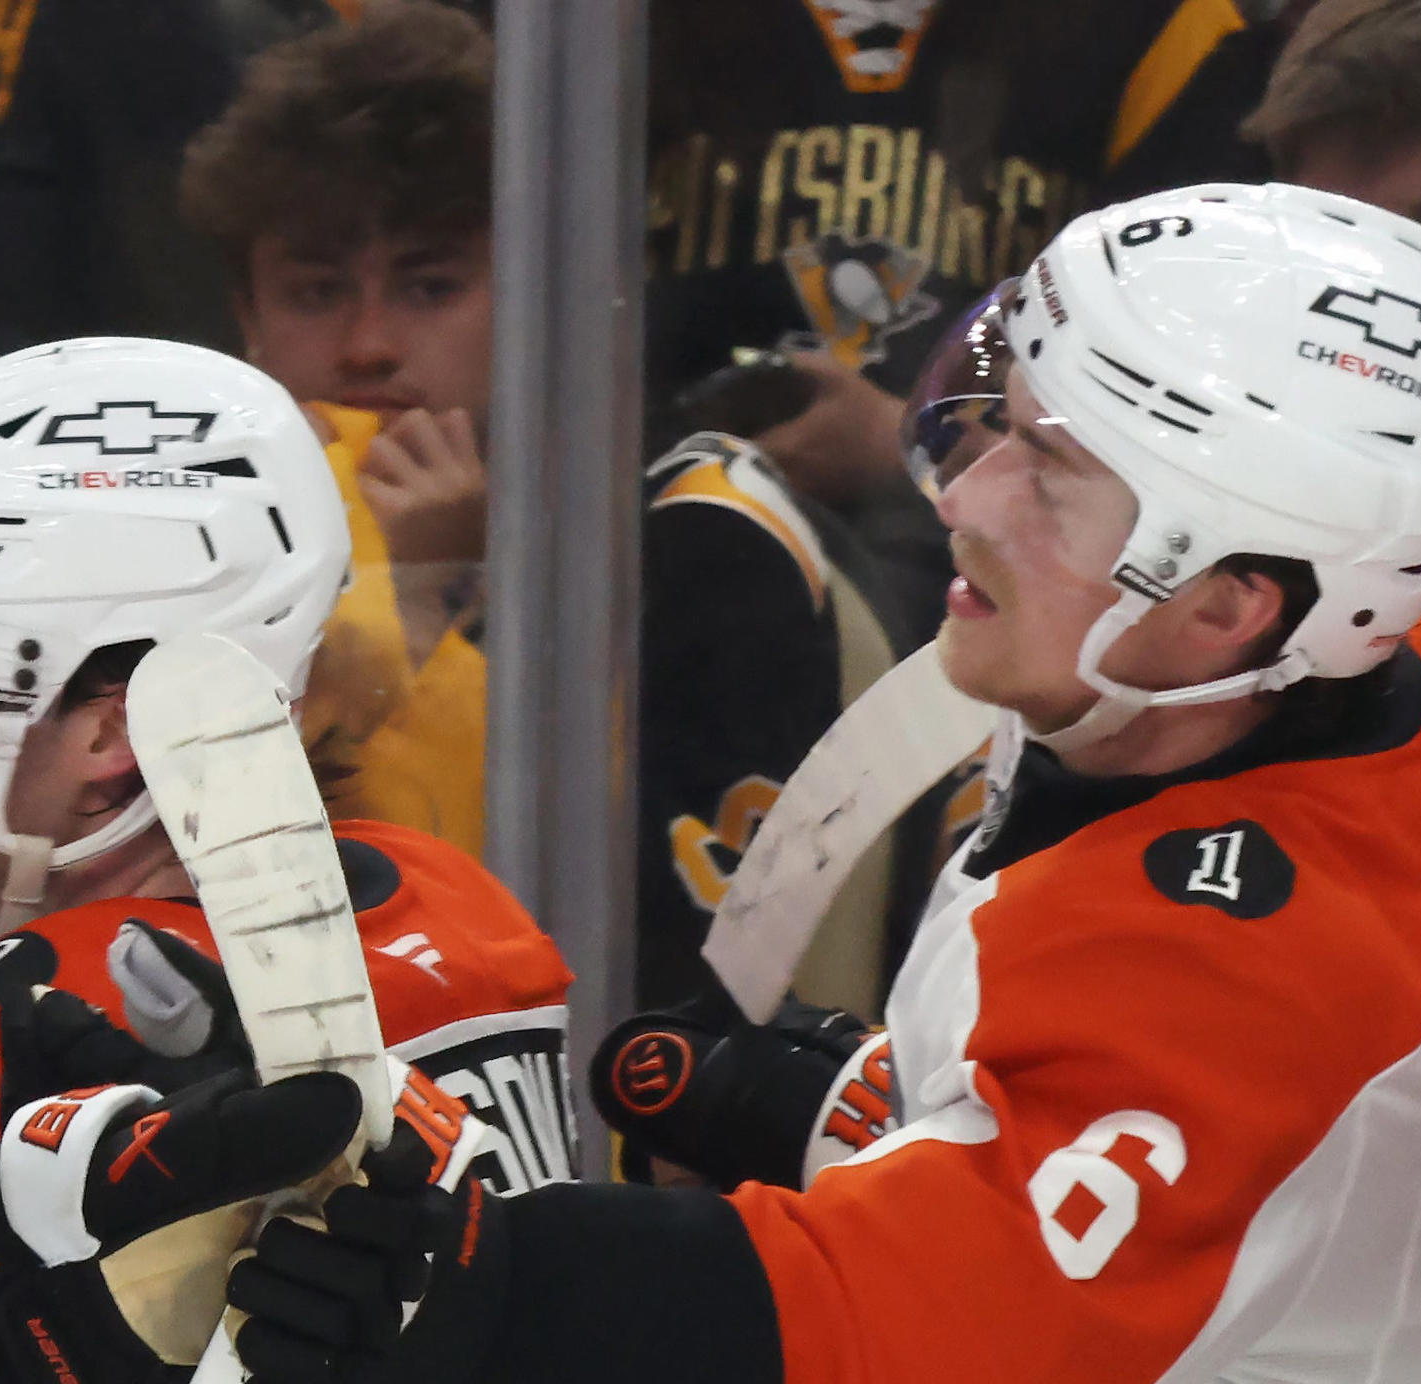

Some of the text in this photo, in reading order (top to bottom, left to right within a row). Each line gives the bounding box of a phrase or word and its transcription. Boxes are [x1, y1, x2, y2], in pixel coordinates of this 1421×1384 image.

[1120, 216, 1194, 247] 6
[37, 470, 217, 489] CHEVROLET
[1186, 830, 1245, 901] 1
[1028, 1109, 1188, 1281] 6
